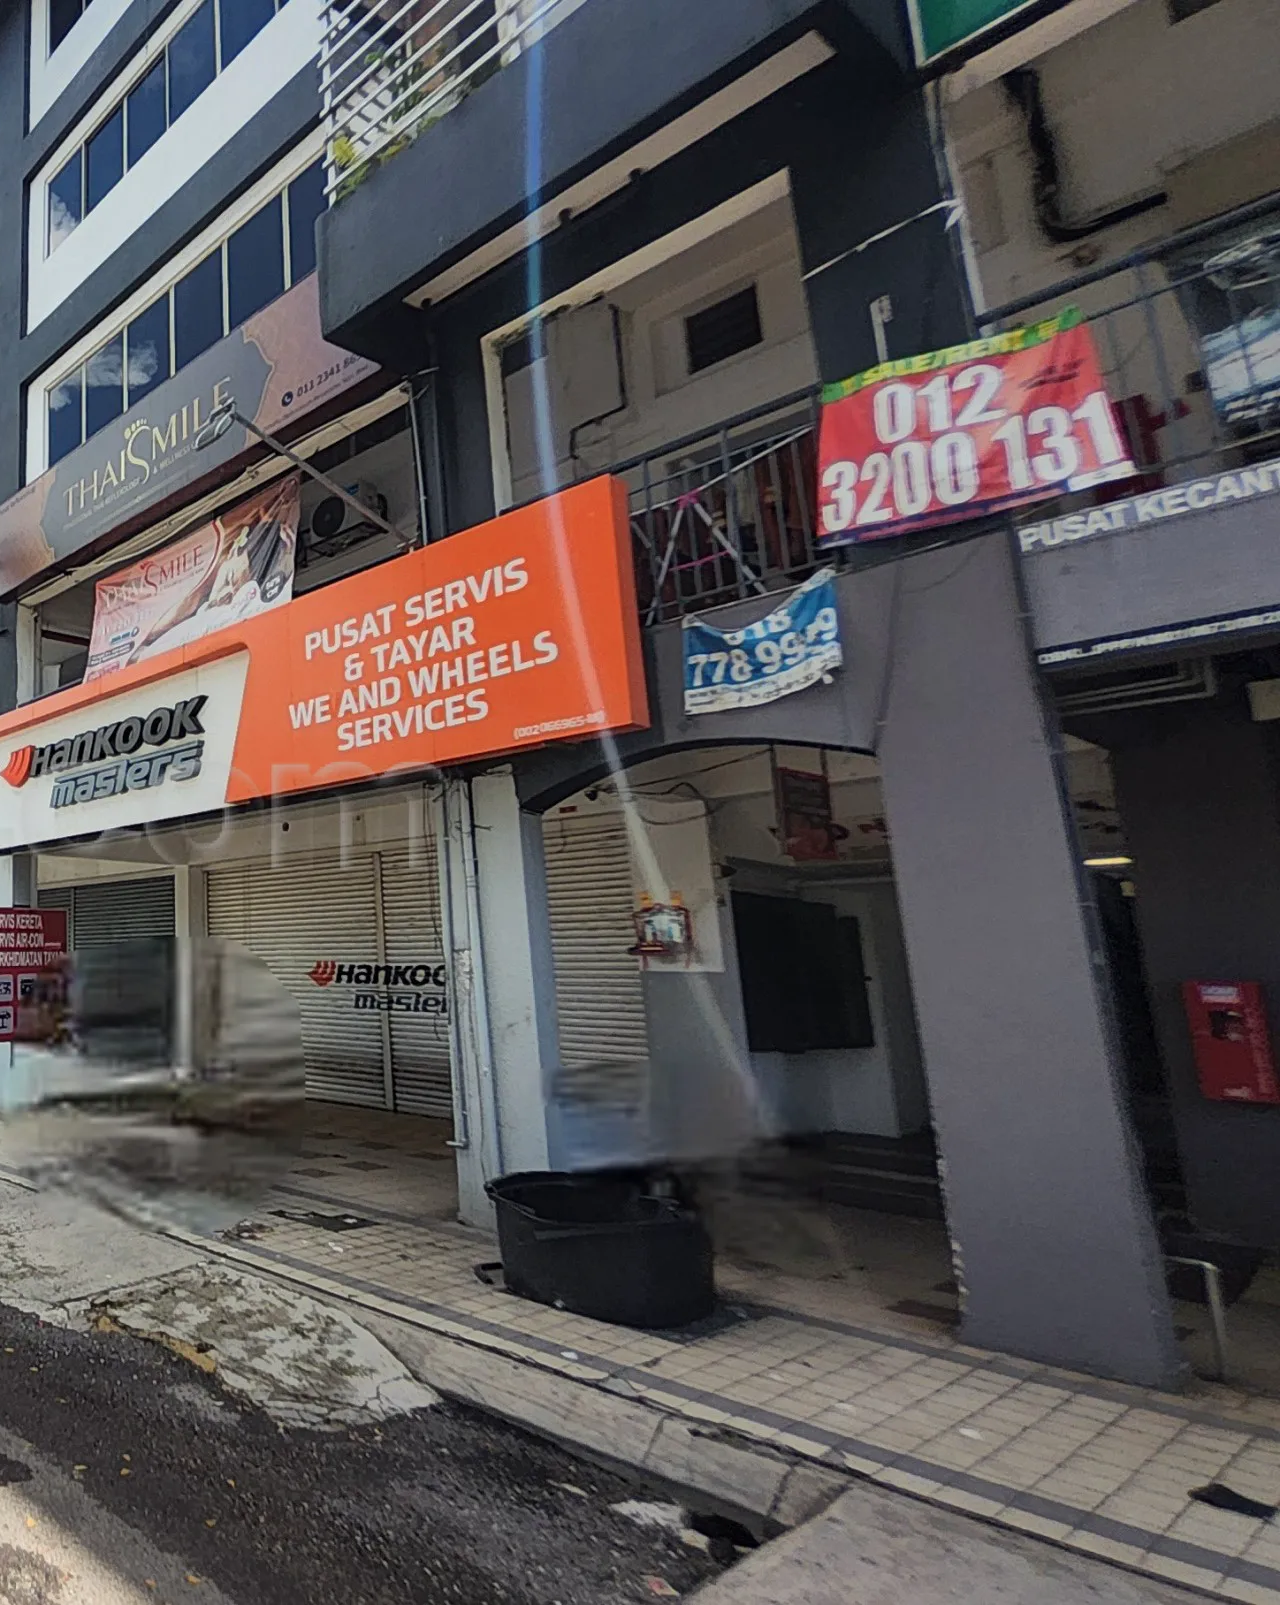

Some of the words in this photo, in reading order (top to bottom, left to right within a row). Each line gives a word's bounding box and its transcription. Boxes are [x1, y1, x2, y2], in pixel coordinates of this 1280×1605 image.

[873, 364, 1009, 445] 012
[820, 432, 980, 534] 3200
[990, 390, 1126, 490] 131
[1018, 502, 1131, 553] PUSAT
[305, 604, 398, 660] PUSAT
[404, 556, 530, 628] SERVIS
[288, 694, 331, 730] WE
[337, 676, 401, 718] AND
[407, 630, 559, 698] WHEELS
[343, 653, 364, 681] &
[371, 616, 477, 673] TAYAR
[687, 649, 754, 687] 778
[337, 688, 490, 751] SERVICES
[16, 914, 43, 930] KERETA
